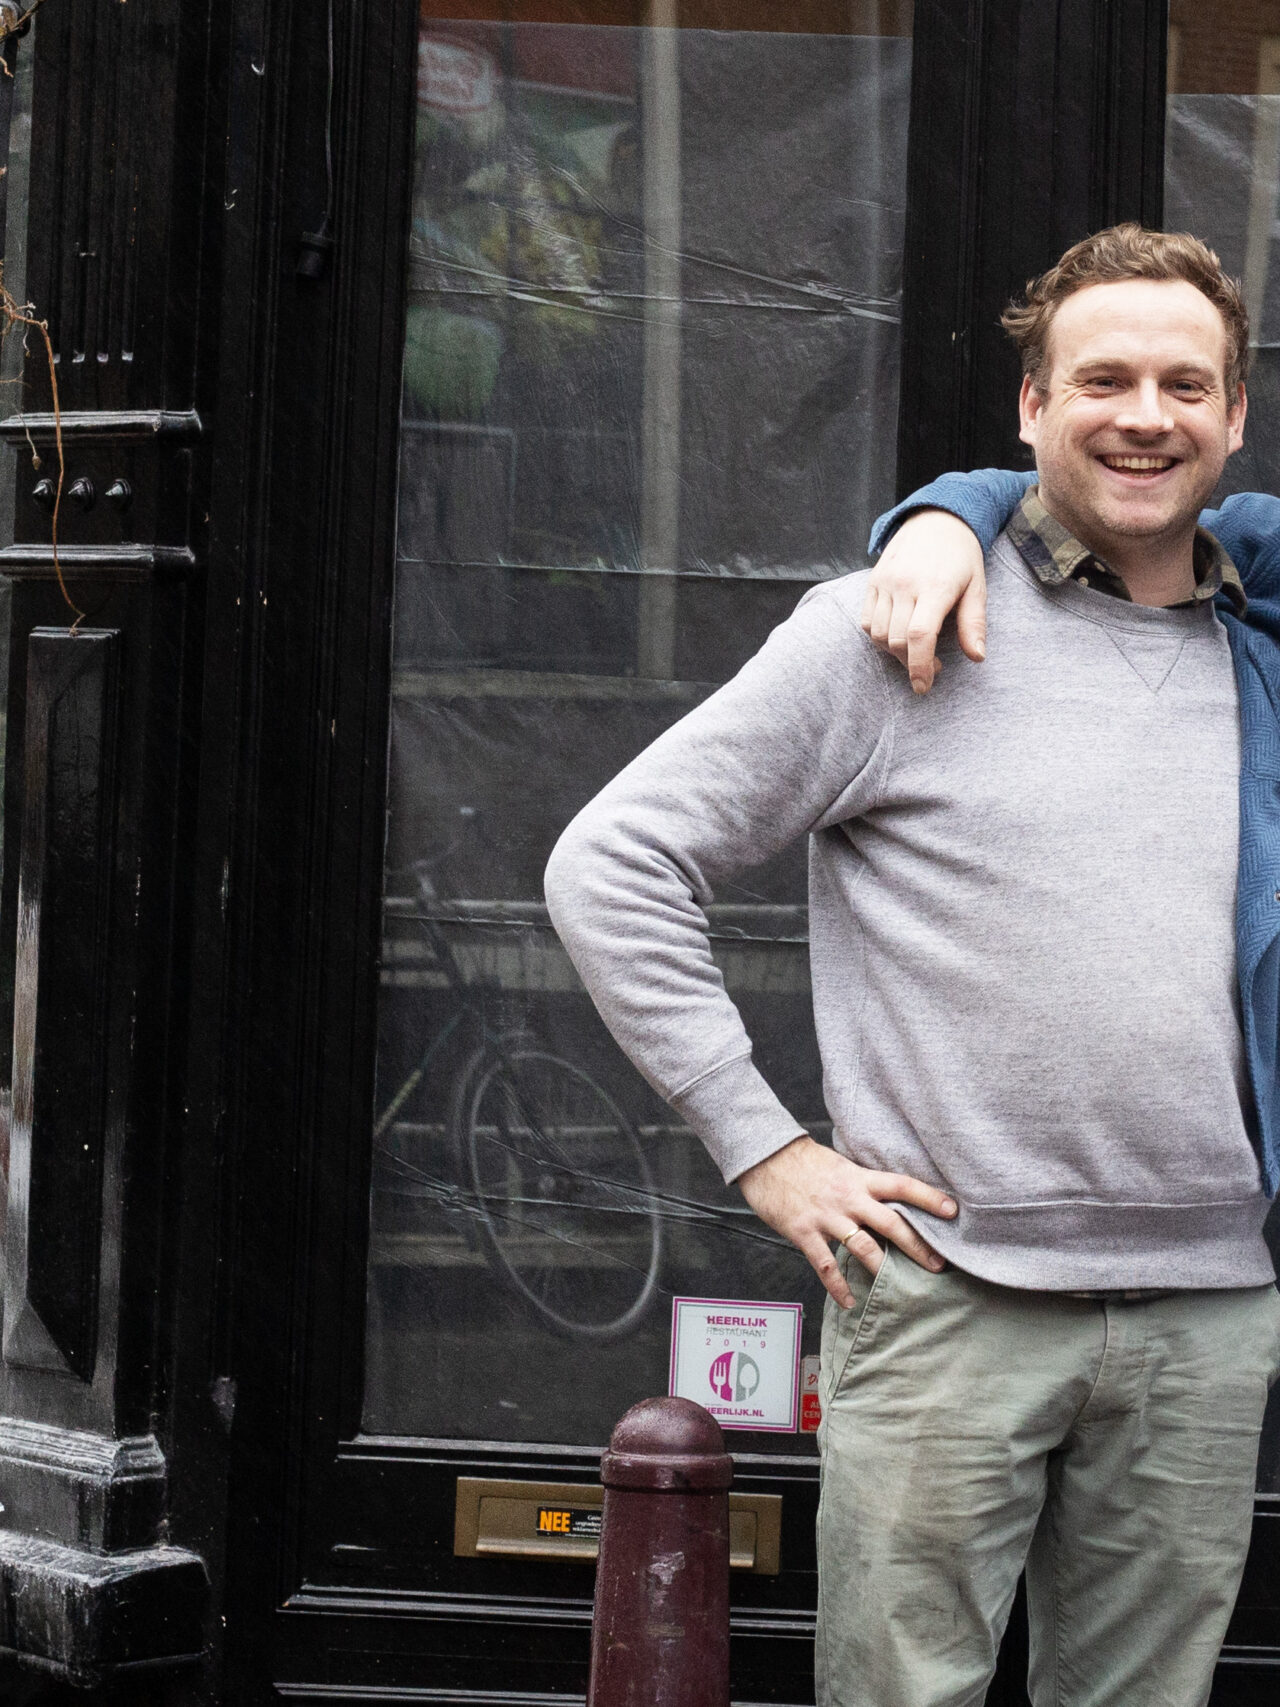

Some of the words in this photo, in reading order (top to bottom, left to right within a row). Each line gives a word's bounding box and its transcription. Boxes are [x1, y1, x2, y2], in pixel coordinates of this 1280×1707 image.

[706, 1315, 767, 1328] HEERLIJK
[706, 1327, 768, 1338] RESTAURANT
[540, 1511, 570, 1532] NEE
